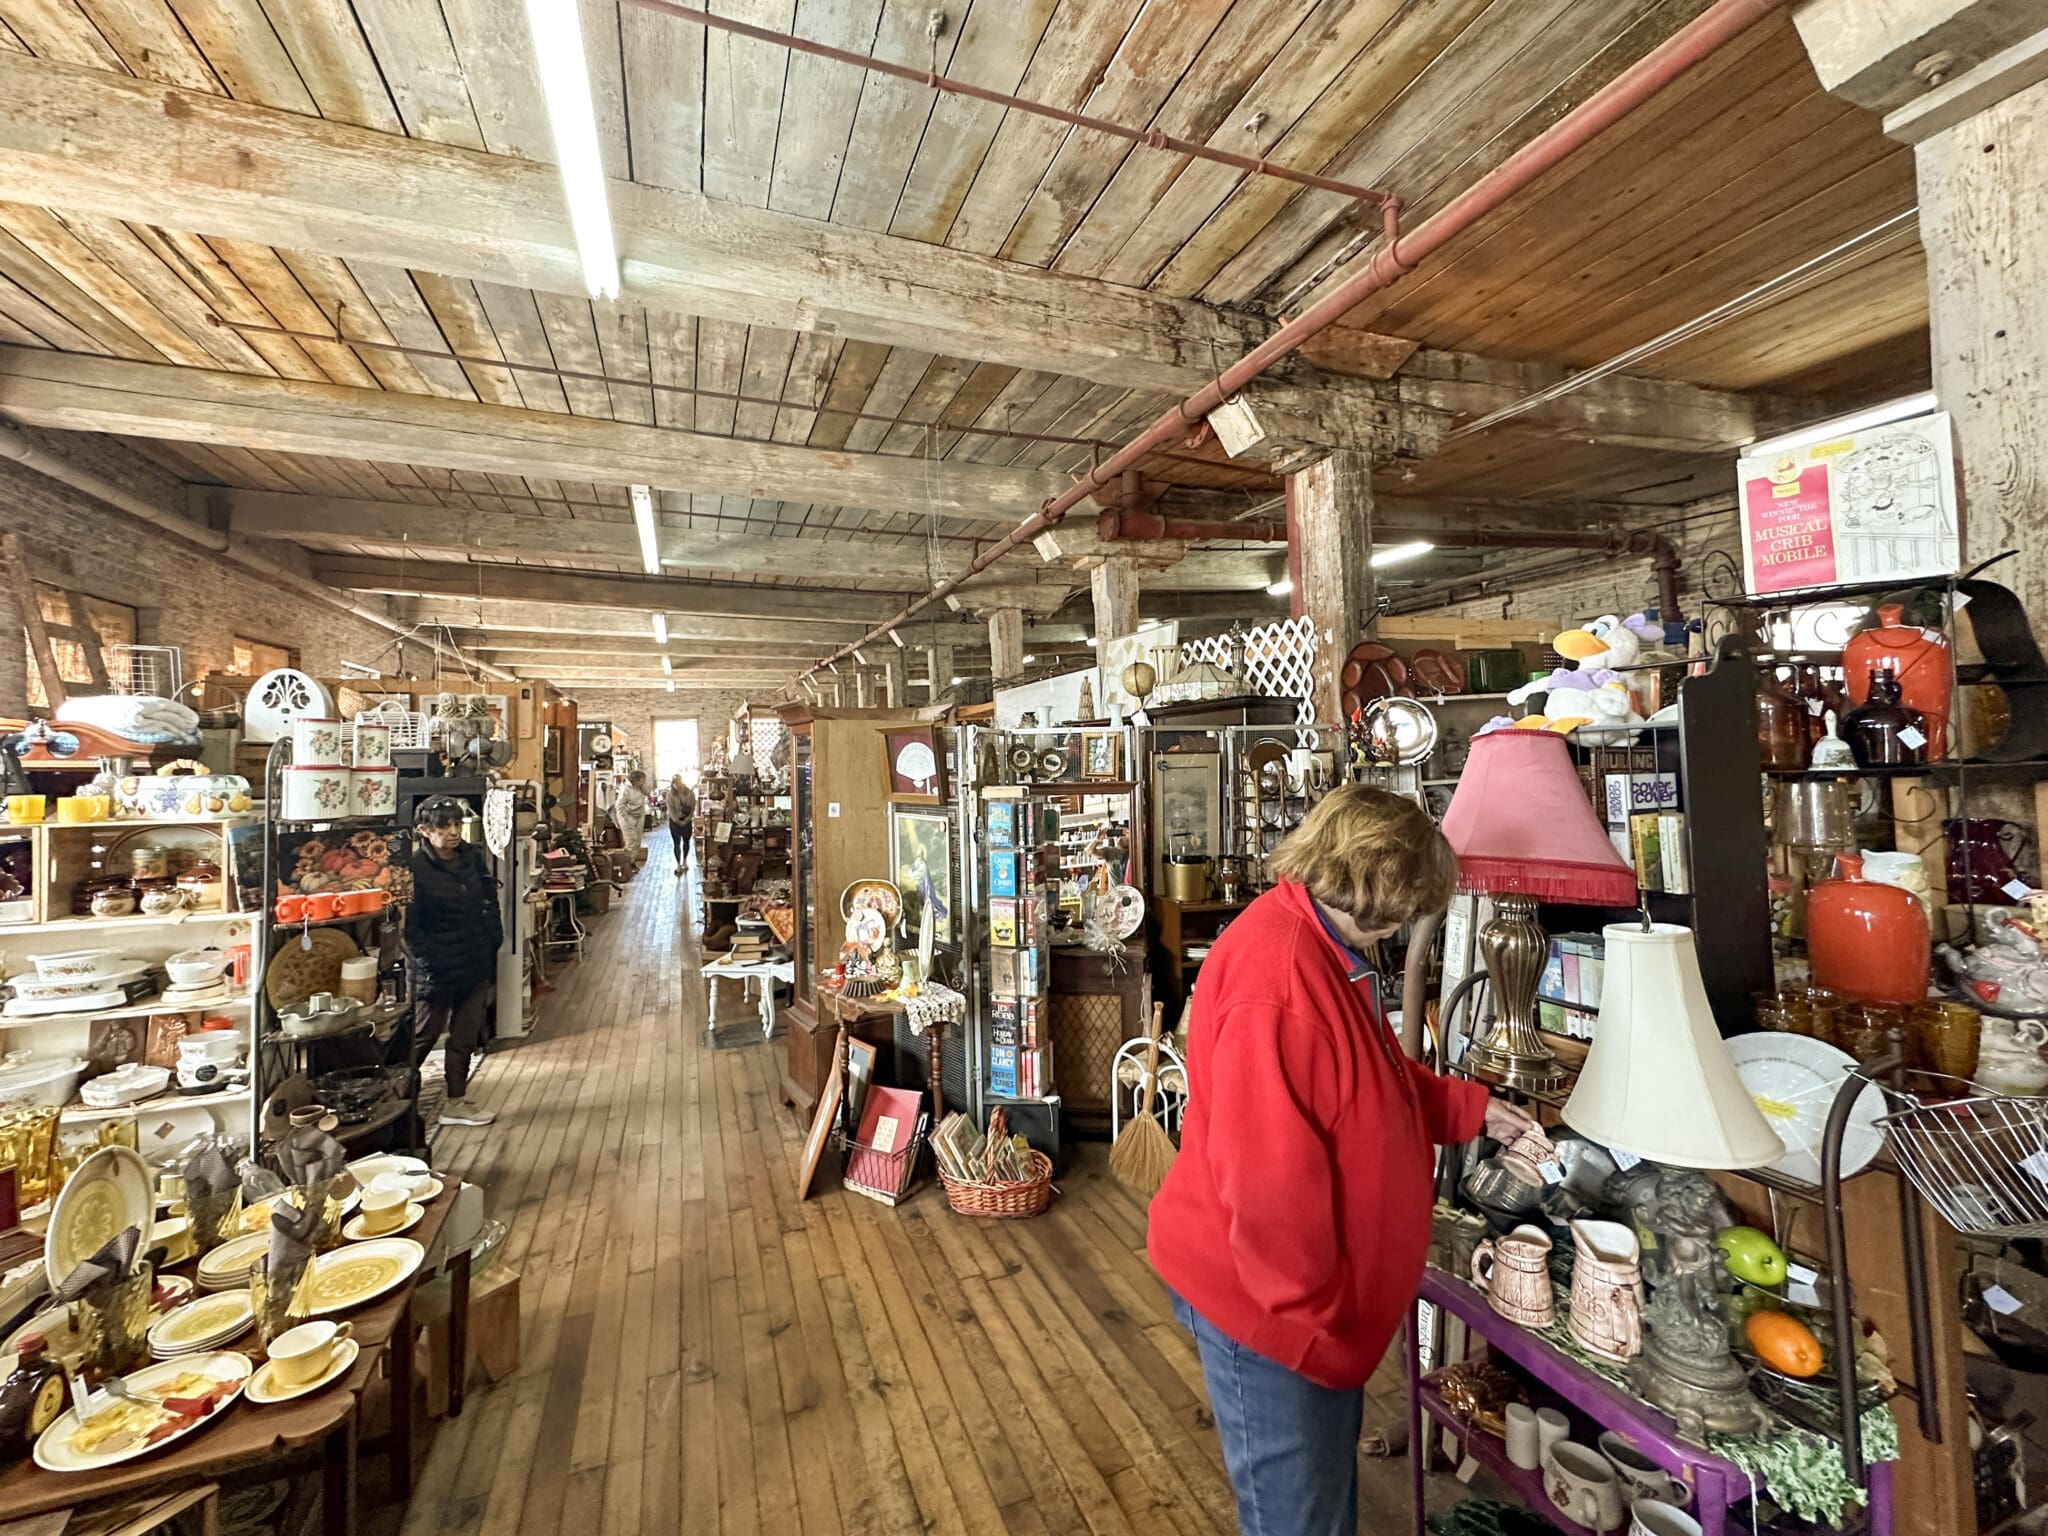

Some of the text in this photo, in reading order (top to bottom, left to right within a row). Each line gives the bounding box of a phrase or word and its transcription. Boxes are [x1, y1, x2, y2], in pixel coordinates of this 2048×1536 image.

[1777, 499, 1797, 508] NEW
[1754, 518, 1827, 542] MUSICAL
[1770, 535, 1813, 552] CRIB
[1761, 545, 1827, 567] MOBILE
[1635, 791, 1677, 804] cover
[992, 1010, 1015, 1020] ROBB
[991, 1047, 1005, 1057] TOM
[991, 1056, 1014, 1067] CLANCY
[991, 1070, 1014, 1079] PATRIOT
[995, 1079, 1015, 1088] GAMES
